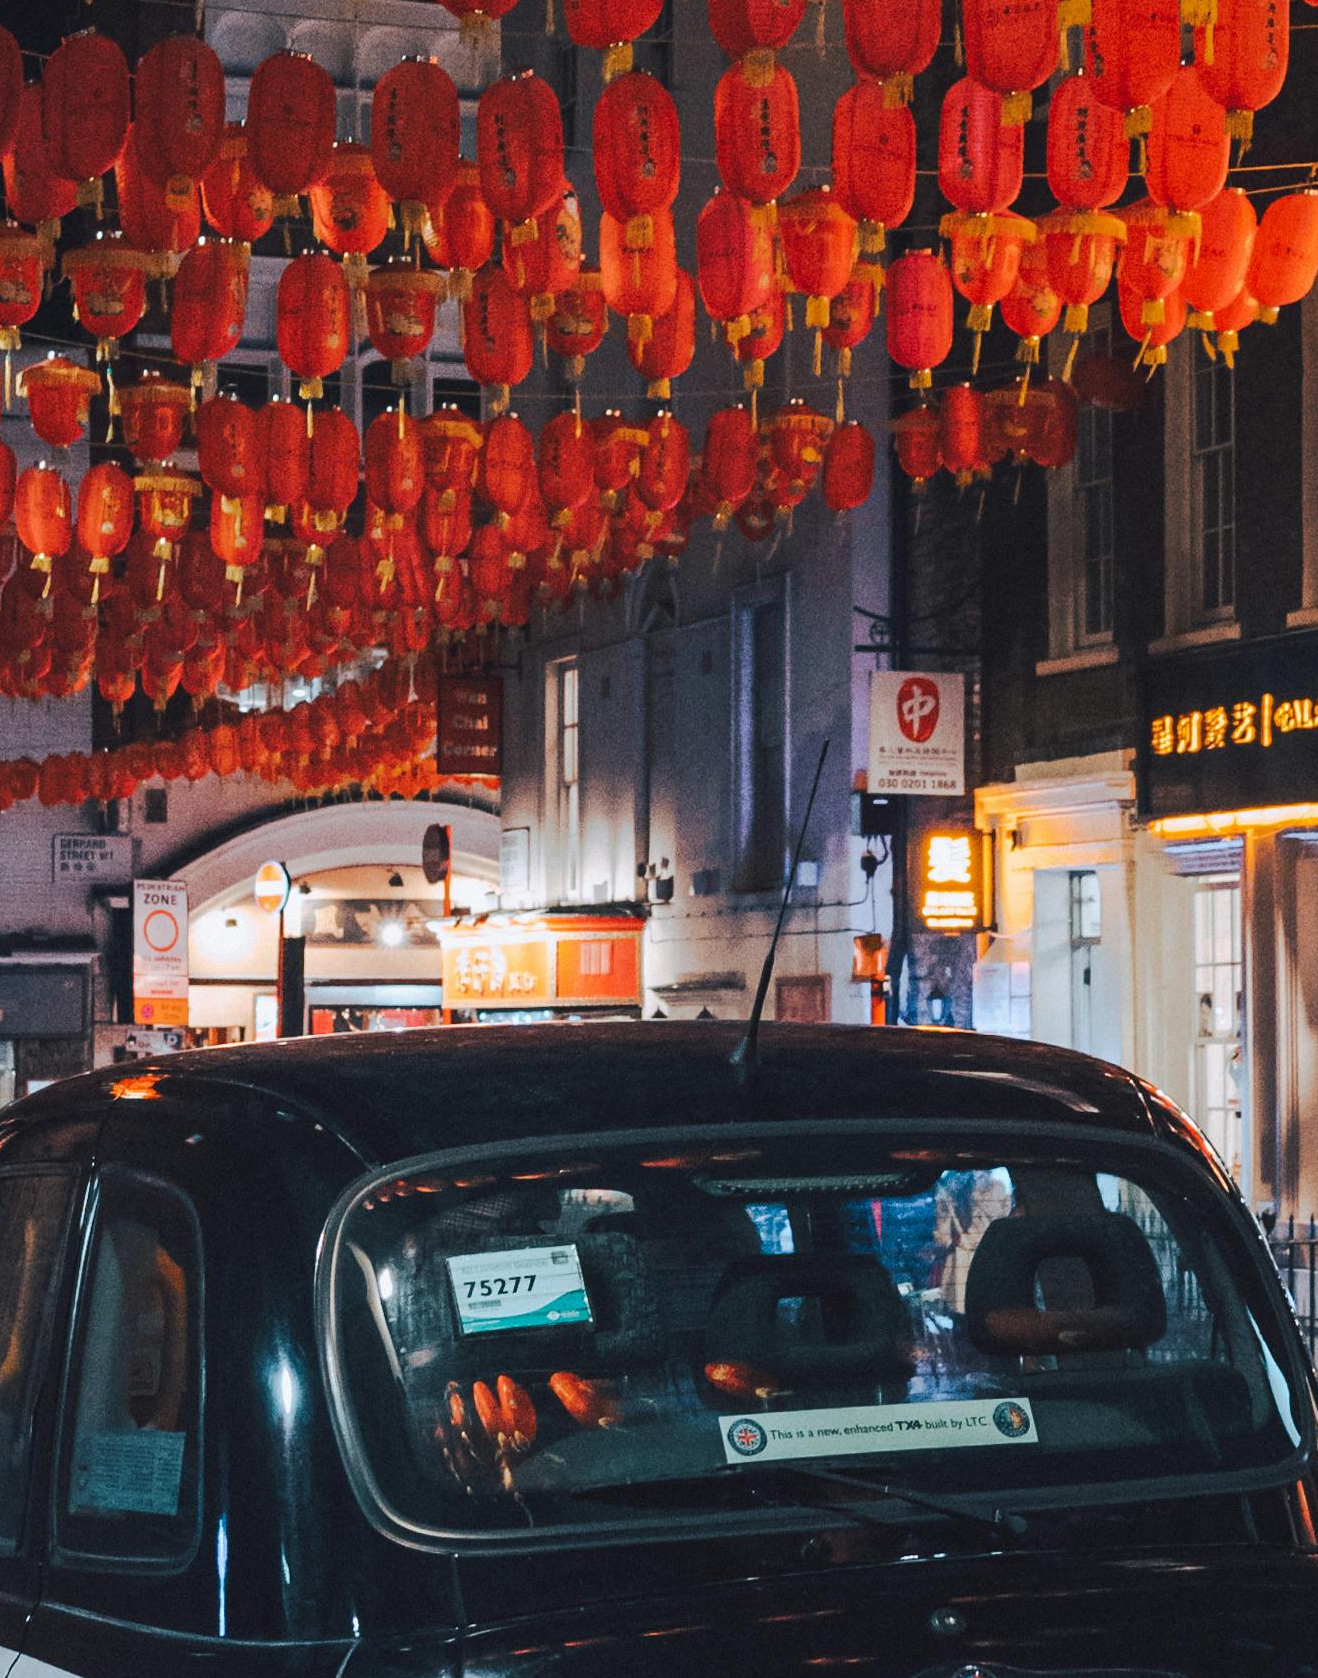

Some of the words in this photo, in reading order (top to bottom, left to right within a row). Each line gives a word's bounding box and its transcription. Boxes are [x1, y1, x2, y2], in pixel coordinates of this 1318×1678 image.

[455, 690, 488, 706] Wan
[454, 714, 489, 731] Chai
[443, 741, 498, 758] Corner
[60, 850, 95, 861] STREET
[143, 893, 177, 905] ZONE
[463, 1274, 538, 1299] 75277
[769, 1428, 793, 1440] This
[796, 1429, 805, 1439] is
[807, 1430, 814, 1438] a
[816, 1428, 842, 1438] new,
[843, 1421, 894, 1435] enhanced
[895, 1420, 923, 1432] TX4
[924, 1418, 948, 1429] built
[950, 1417, 963, 1430] by
